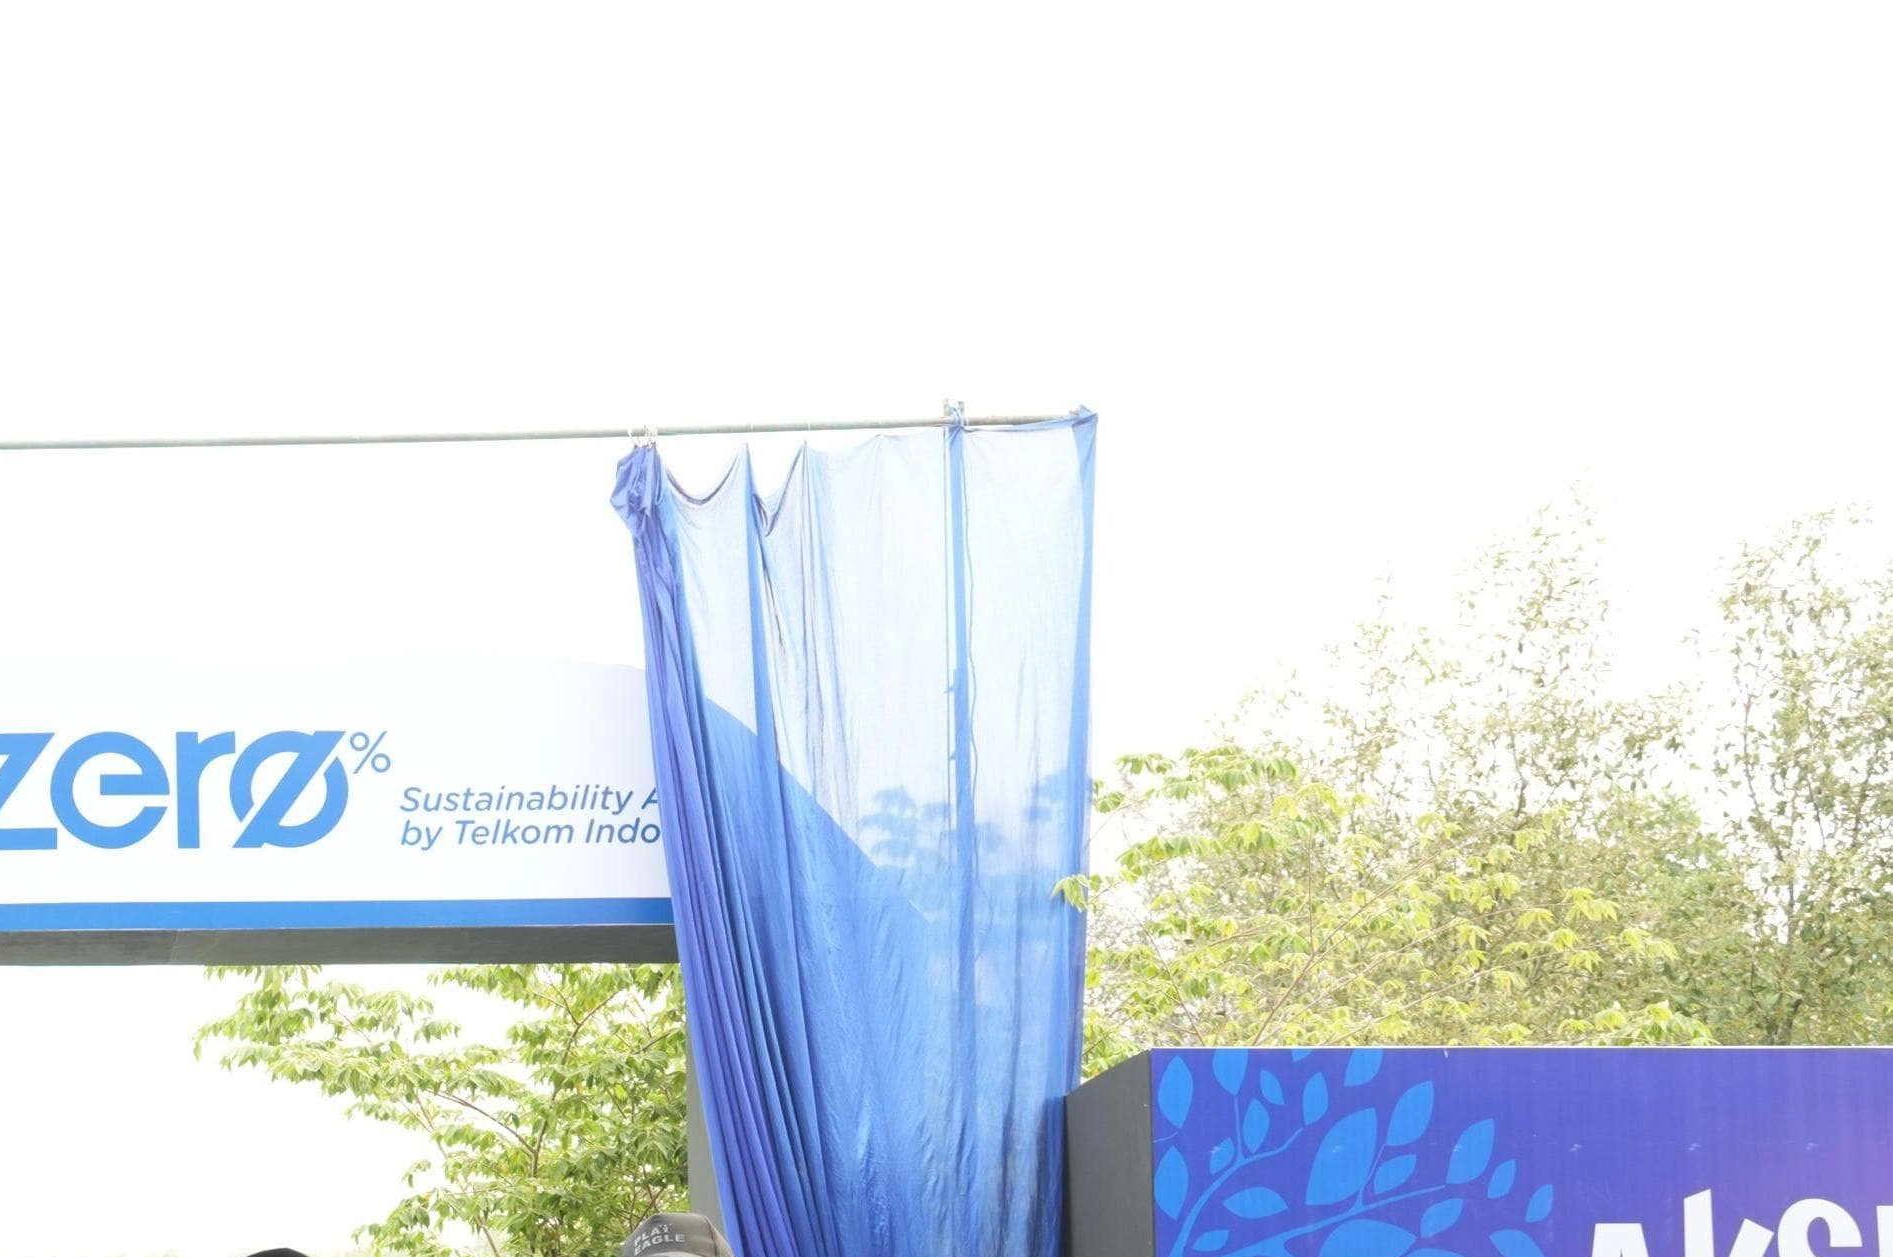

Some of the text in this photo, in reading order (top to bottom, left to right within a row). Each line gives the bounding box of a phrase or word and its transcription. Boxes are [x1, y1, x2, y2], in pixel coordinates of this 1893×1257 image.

[400, 784, 633, 815] Sustainability
[401, 817, 662, 850] by Telkom Indo
[634, 1234, 686, 1256] EAGLE
